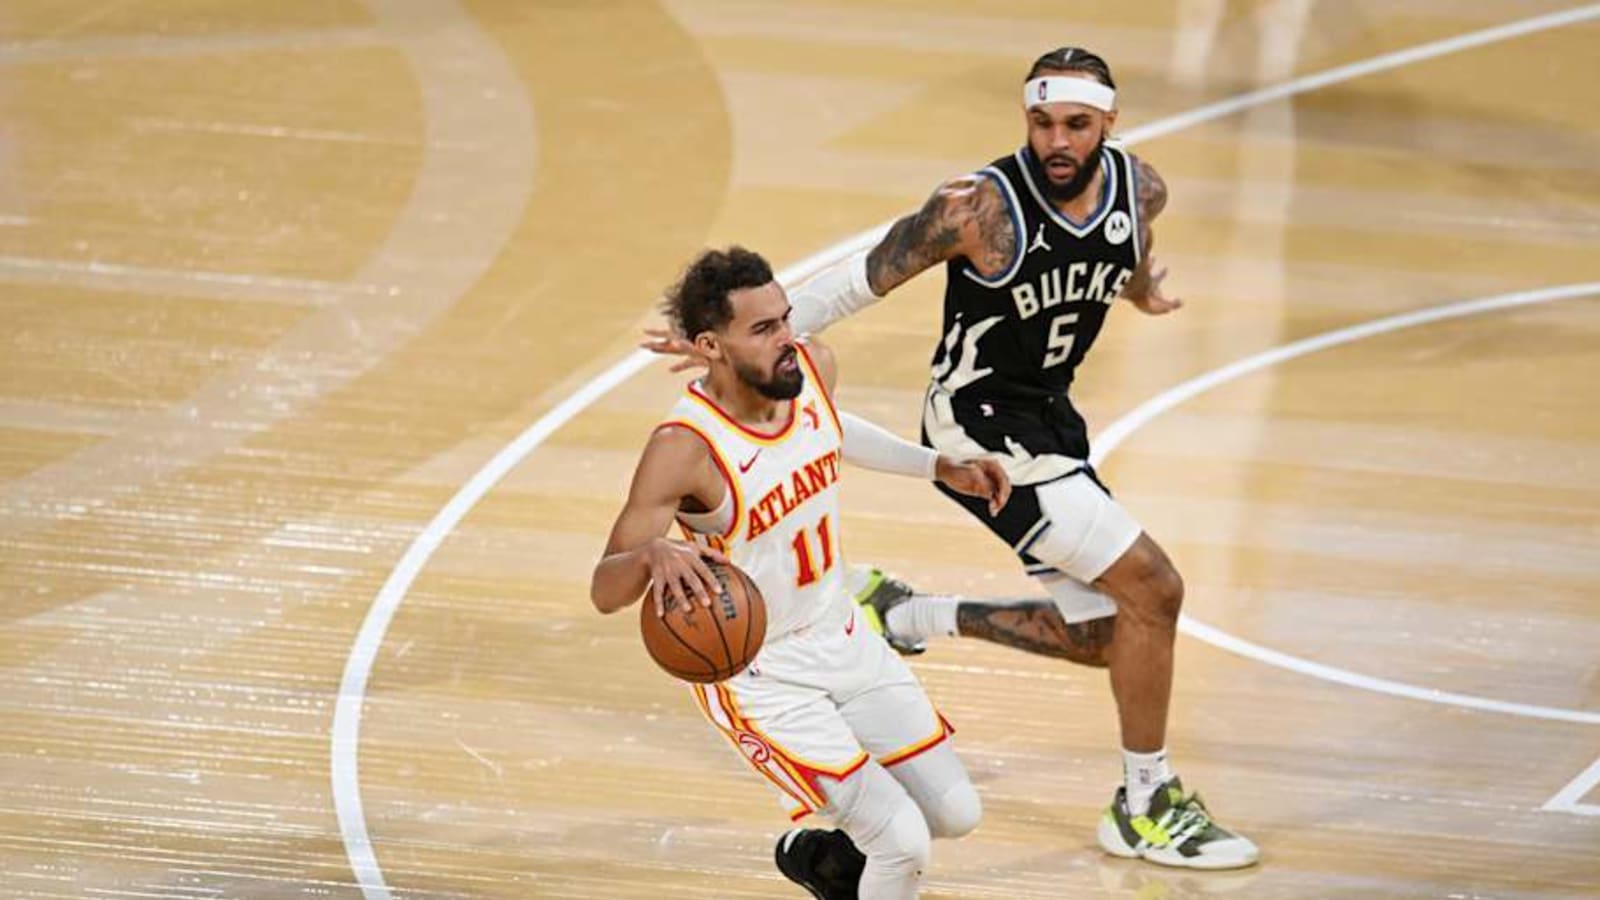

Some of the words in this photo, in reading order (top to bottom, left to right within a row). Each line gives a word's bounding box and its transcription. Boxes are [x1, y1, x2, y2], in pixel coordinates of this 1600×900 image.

[1012, 261, 1132, 320] BUCKS
[1042, 312, 1079, 369] 5
[746, 450, 839, 541] ATLANT
[791, 513, 834, 588] 11
